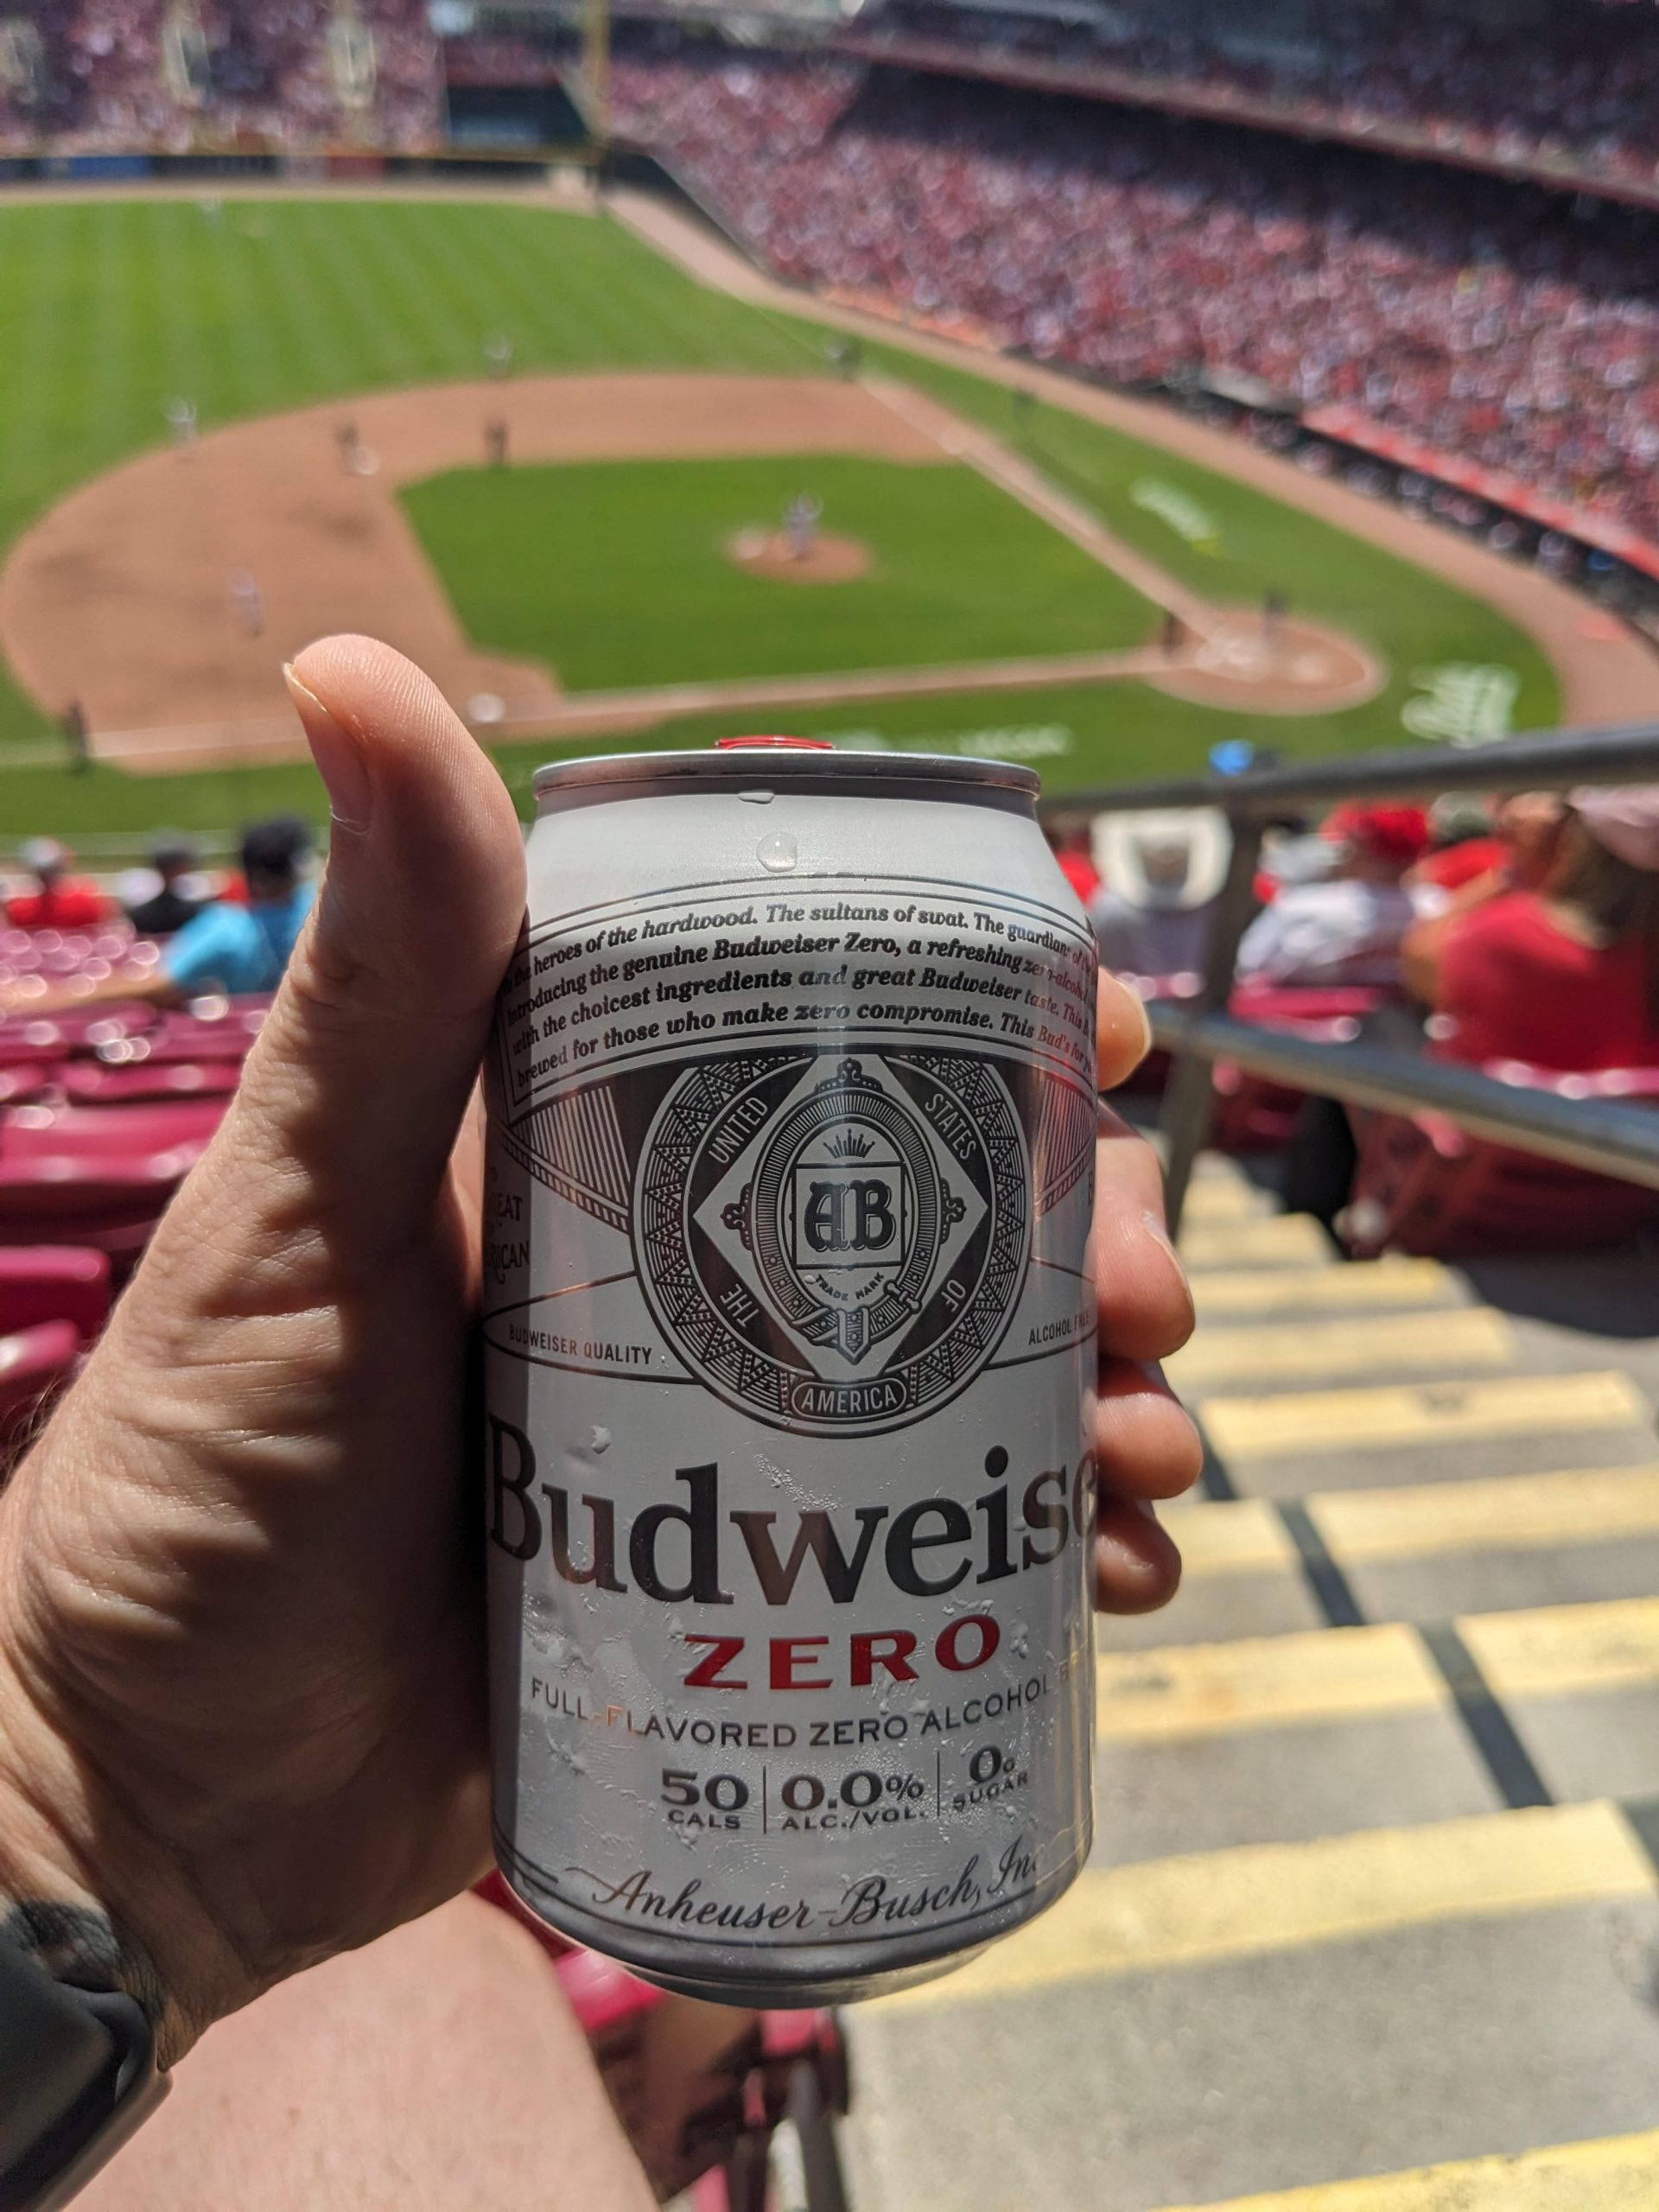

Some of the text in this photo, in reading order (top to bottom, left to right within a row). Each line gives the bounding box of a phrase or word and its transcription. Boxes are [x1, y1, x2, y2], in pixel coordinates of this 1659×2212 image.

[533, 942, 582, 976] heroes
[585, 930, 607, 954] of
[607, 925, 638, 948] the
[641, 906, 758, 940] hardwood.
[766, 902, 804, 924] The
[809, 902, 888, 922] sultans
[893, 904, 917, 924] of
[917, 910, 969, 929] swat.
[973, 912, 1004, 934] The
[590, 963, 620, 985] the
[623, 945, 709, 981] genuine
[712, 933, 840, 961] Budweiser
[843, 931, 902, 957] Zero,
[907, 940, 921, 955] a
[927, 938, 1022, 975] refreshing
[543, 1014, 567, 1038] the
[570, 986, 651, 1026] choicest
[657, 968, 791, 1002] ingredients
[798, 963, 849, 986] and
[851, 968, 916, 989] great
[918, 967, 1023, 1001] Budweiser
[1024, 988, 1059, 1015] taste.
[1063, 1002, 1083, 1031] This
[518, 1045, 569, 1088] brewed
[573, 1038, 599, 1060] for
[604, 1022, 659, 1049] those
[666, 1009, 715, 1036] who
[721, 1001, 788, 1026] make
[794, 1003, 850, 1020] zero
[856, 1002, 994, 1030] compromise.
[1000, 1012, 1035, 1039] This
[1037, 1024, 1071, 1054] Bud's
[708, 1092, 977, 1414] THE UNITED STATES OF AMERICA
[814, 1272, 885, 1301] TRADE MARK
[509, 1323, 652, 1365] BUDWEISER QUALITY
[1028, 1317, 1072, 1346] ALCOHOL
[683, 1613, 1001, 1690] ZERO
[531, 1673, 1052, 1747] FULL-FLAVORED ZERO ALCOHOL
[660, 1767, 750, 1811] 50
[780, 1769, 925, 1812] 0.0%
[667, 1808, 741, 1830] CALS
[780, 1807, 926, 1832] ALC./VOL.
